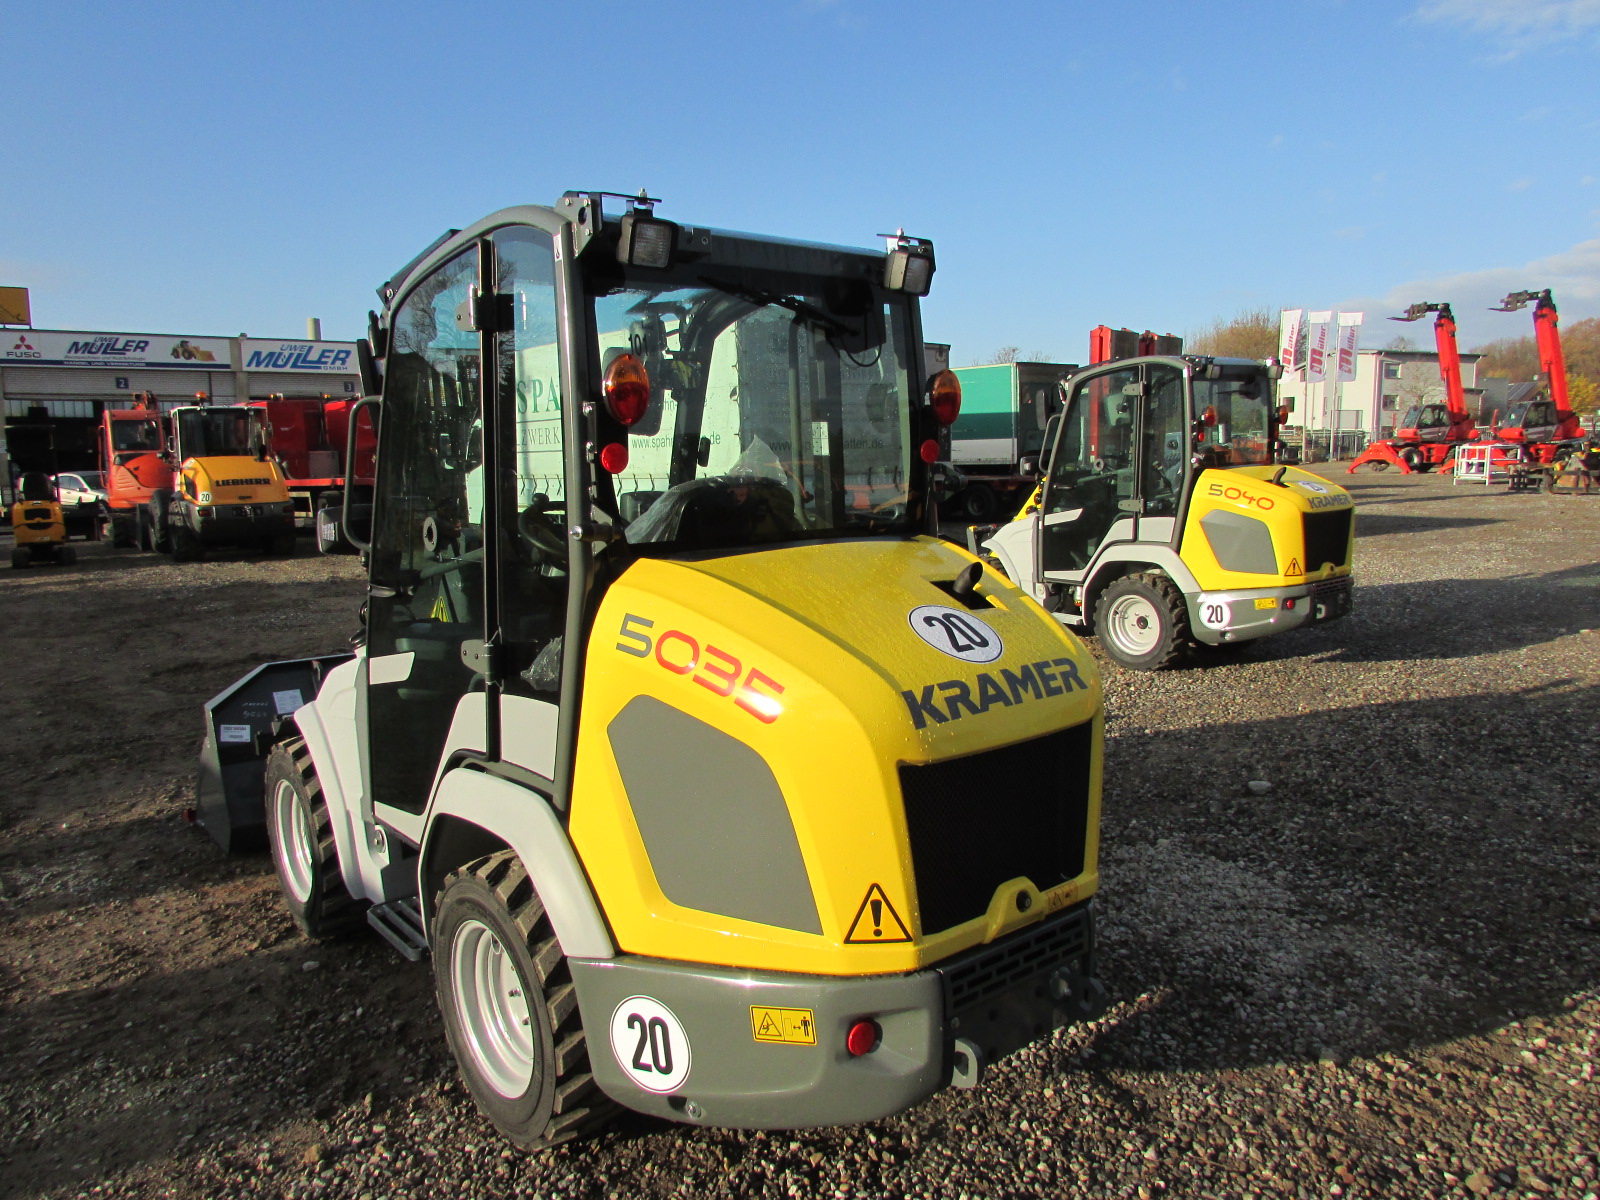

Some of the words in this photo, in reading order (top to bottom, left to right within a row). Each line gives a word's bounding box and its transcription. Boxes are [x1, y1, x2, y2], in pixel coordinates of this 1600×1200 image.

[246, 345, 352, 370] MÜLLER
[281, 343, 307, 352] UWE
[517, 427, 560, 446] ZWERK
[215, 478, 271, 487] LIEBHERR
[201, 493, 210, 502] 20
[1208, 483, 1275, 510] 5040
[1307, 494, 1350, 509] KRAMER
[1206, 604, 1223, 624] 20
[922, 611, 988, 653] 20
[615, 612, 786, 725] 5035
[901, 657, 1088, 731] KRAMER
[627, 1012, 673, 1075] 20
